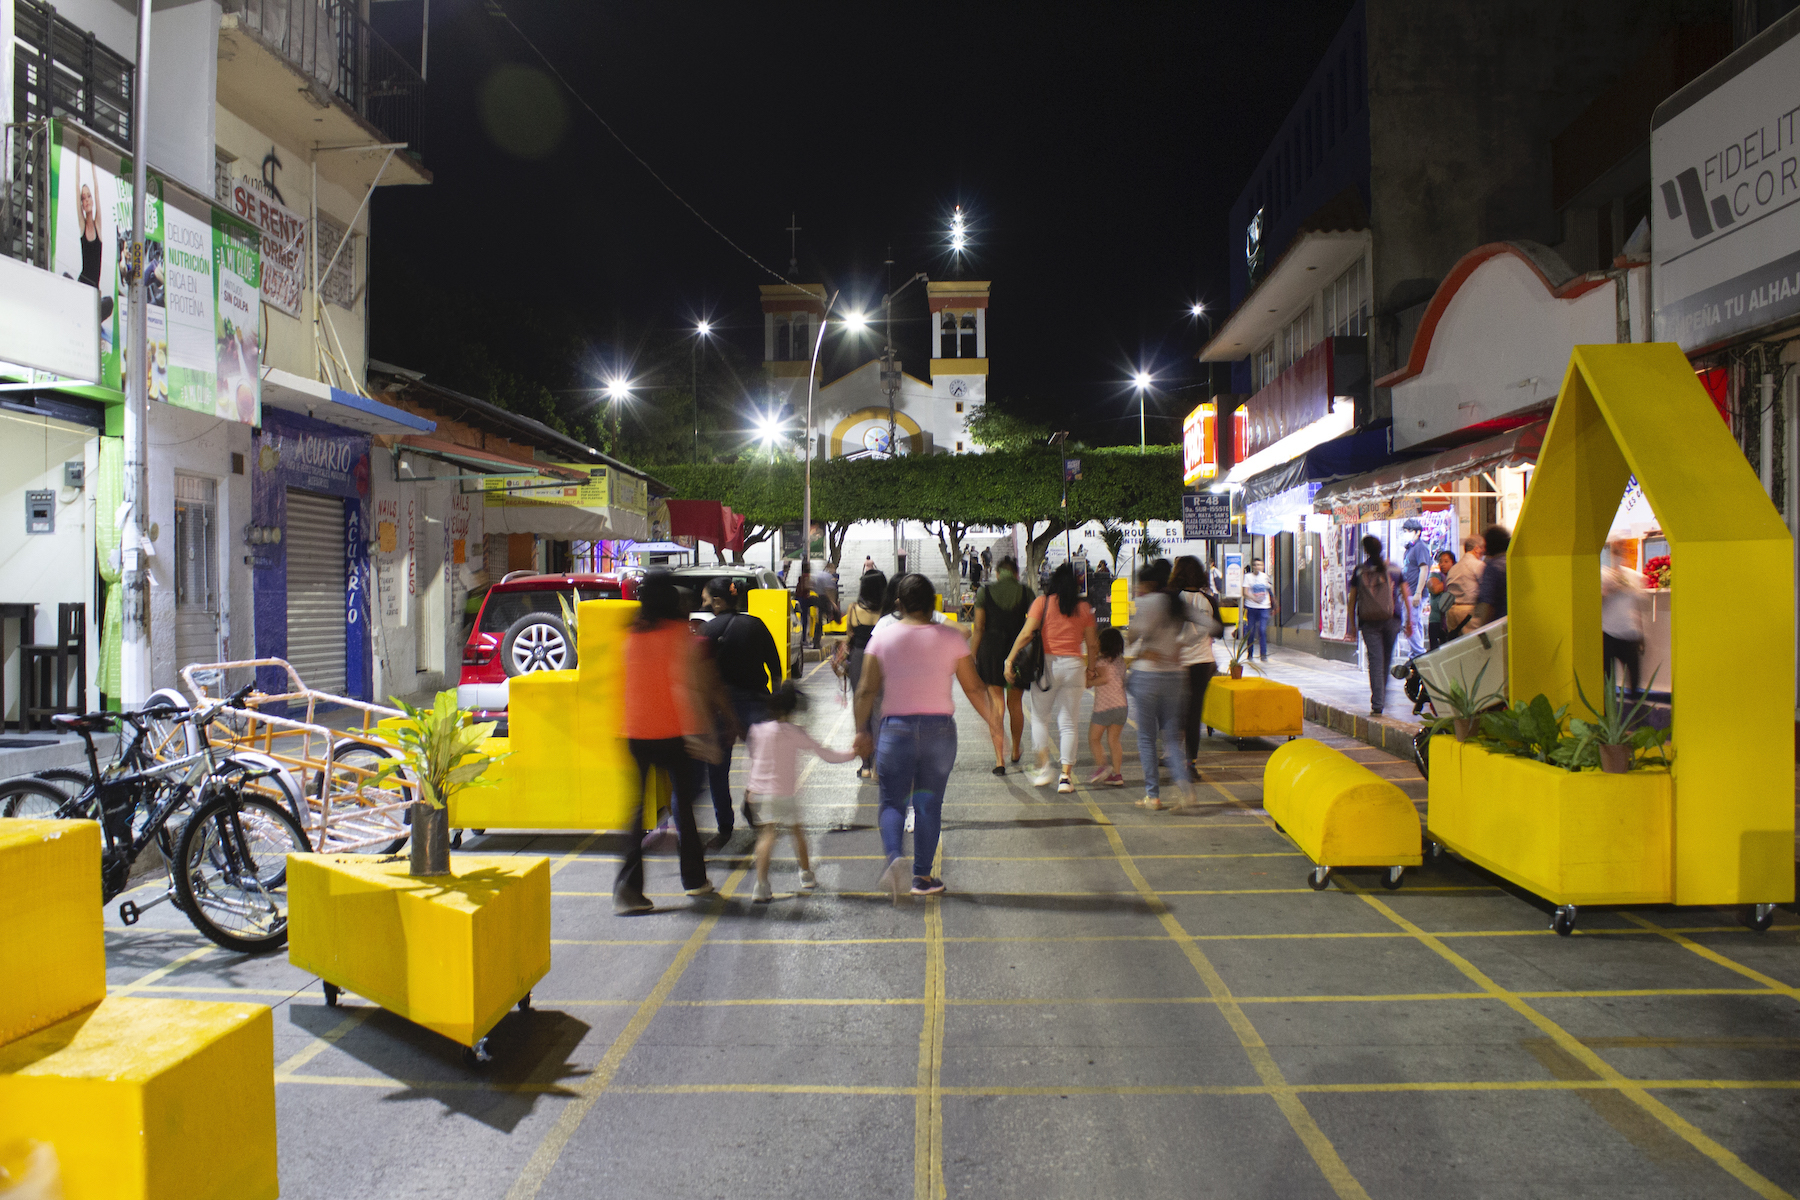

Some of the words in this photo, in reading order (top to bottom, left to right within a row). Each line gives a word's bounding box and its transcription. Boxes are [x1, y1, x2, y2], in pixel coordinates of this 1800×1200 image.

[1732, 156, 1798, 217] COR
[234, 186, 257, 224] SE
[259, 200, 305, 251] RENTA
[167, 222, 204, 250] DELICIOSA
[168, 247, 210, 276] NUTRICIÓN
[169, 269, 186, 290] RICA
[187, 275, 198, 294] EN
[169, 292, 205, 318] PROTEÍNA
[223, 290, 233, 304] SIN
[233, 295, 249, 314] CULPA
[1724, 293, 1745, 320] TU
[1748, 271, 1800, 313] ALHAJ
[294, 433, 352, 473] ACUARIO
[377, 500, 397, 518] NAILS
[452, 494, 470, 511] NAILS
[1193, 496, 1219, 506] R-48
[1361, 503, 1380, 514] $100
[1165, 528, 1178, 537] ES
[347, 510, 360, 624] ACUARIO
